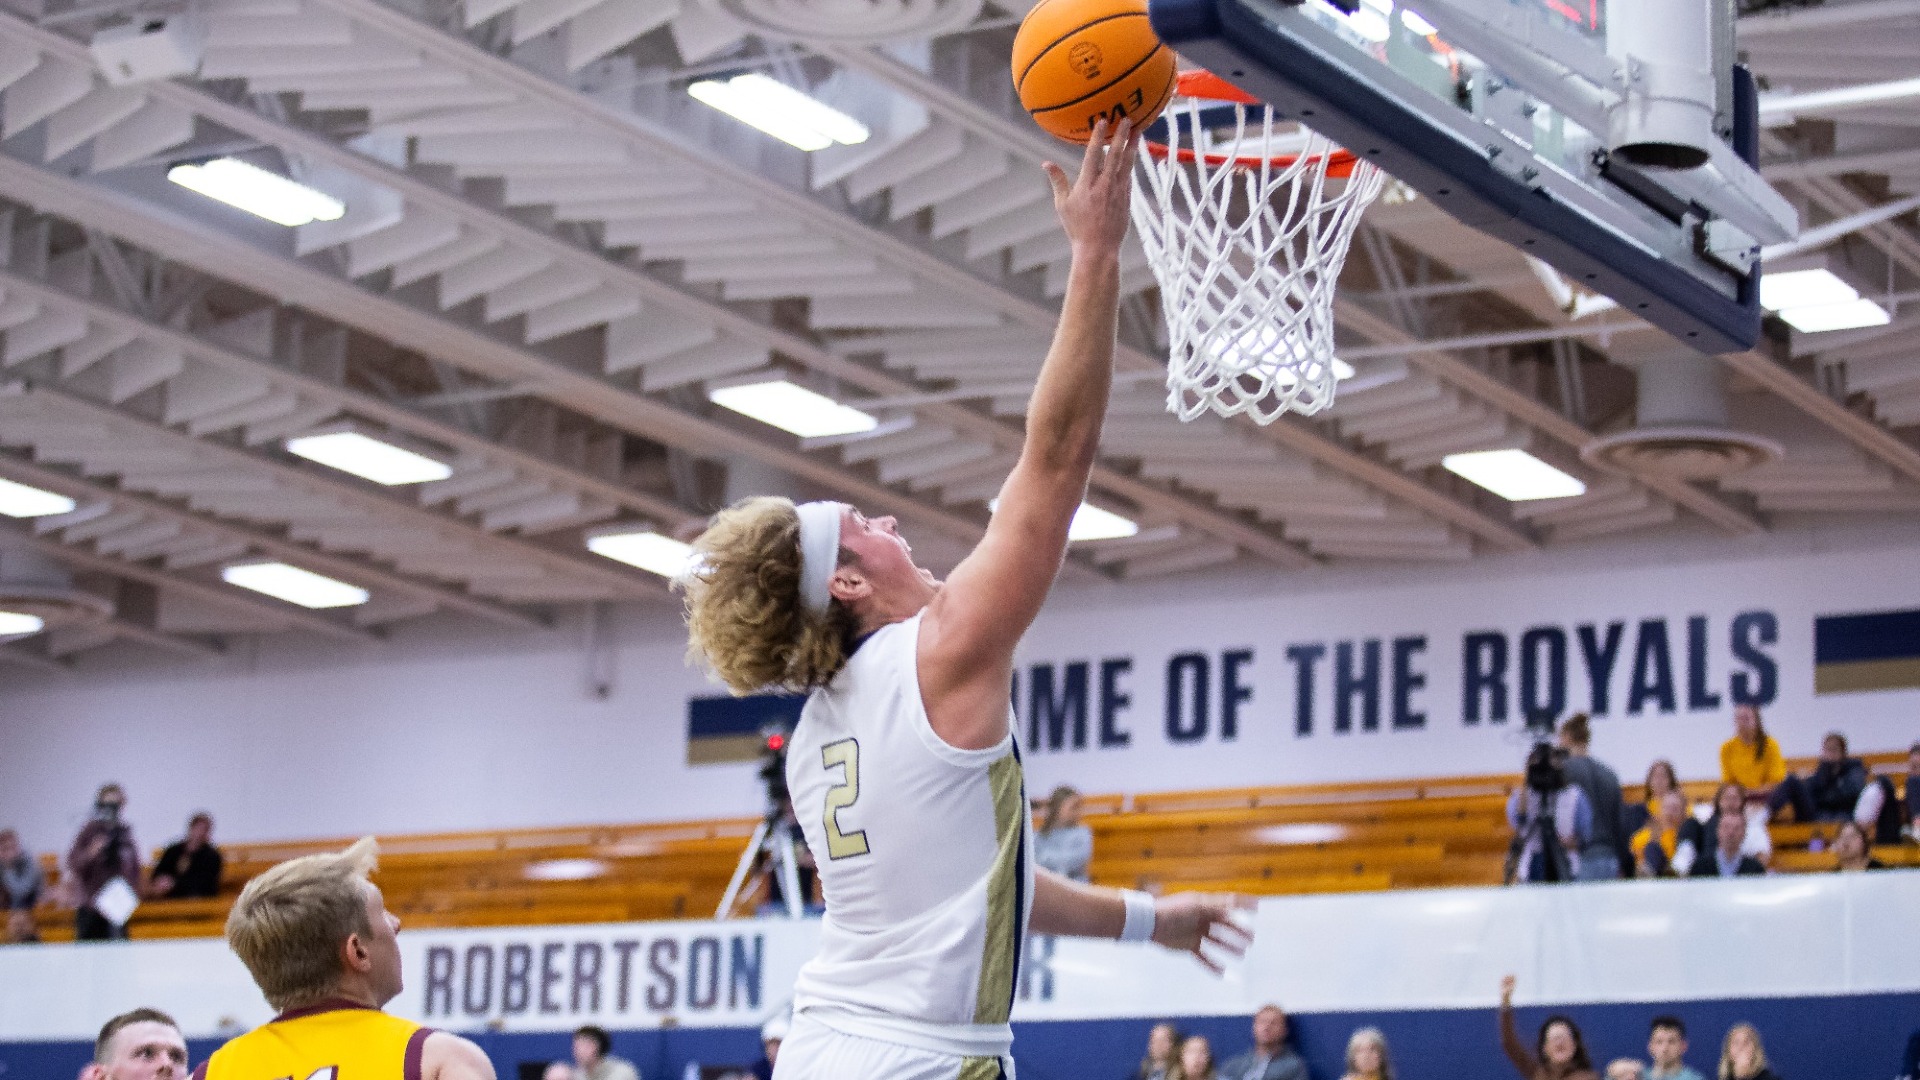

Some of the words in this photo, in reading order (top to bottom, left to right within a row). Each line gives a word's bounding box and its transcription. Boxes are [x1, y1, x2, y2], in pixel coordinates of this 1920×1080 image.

[1011, 655, 1133, 754] ME
[1163, 645, 1254, 746] OF
[1285, 635, 1427, 739] THE
[1461, 610, 1779, 727] ROYALS
[821, 737, 871, 861] 2
[424, 934, 764, 1016] ROBERTSON
